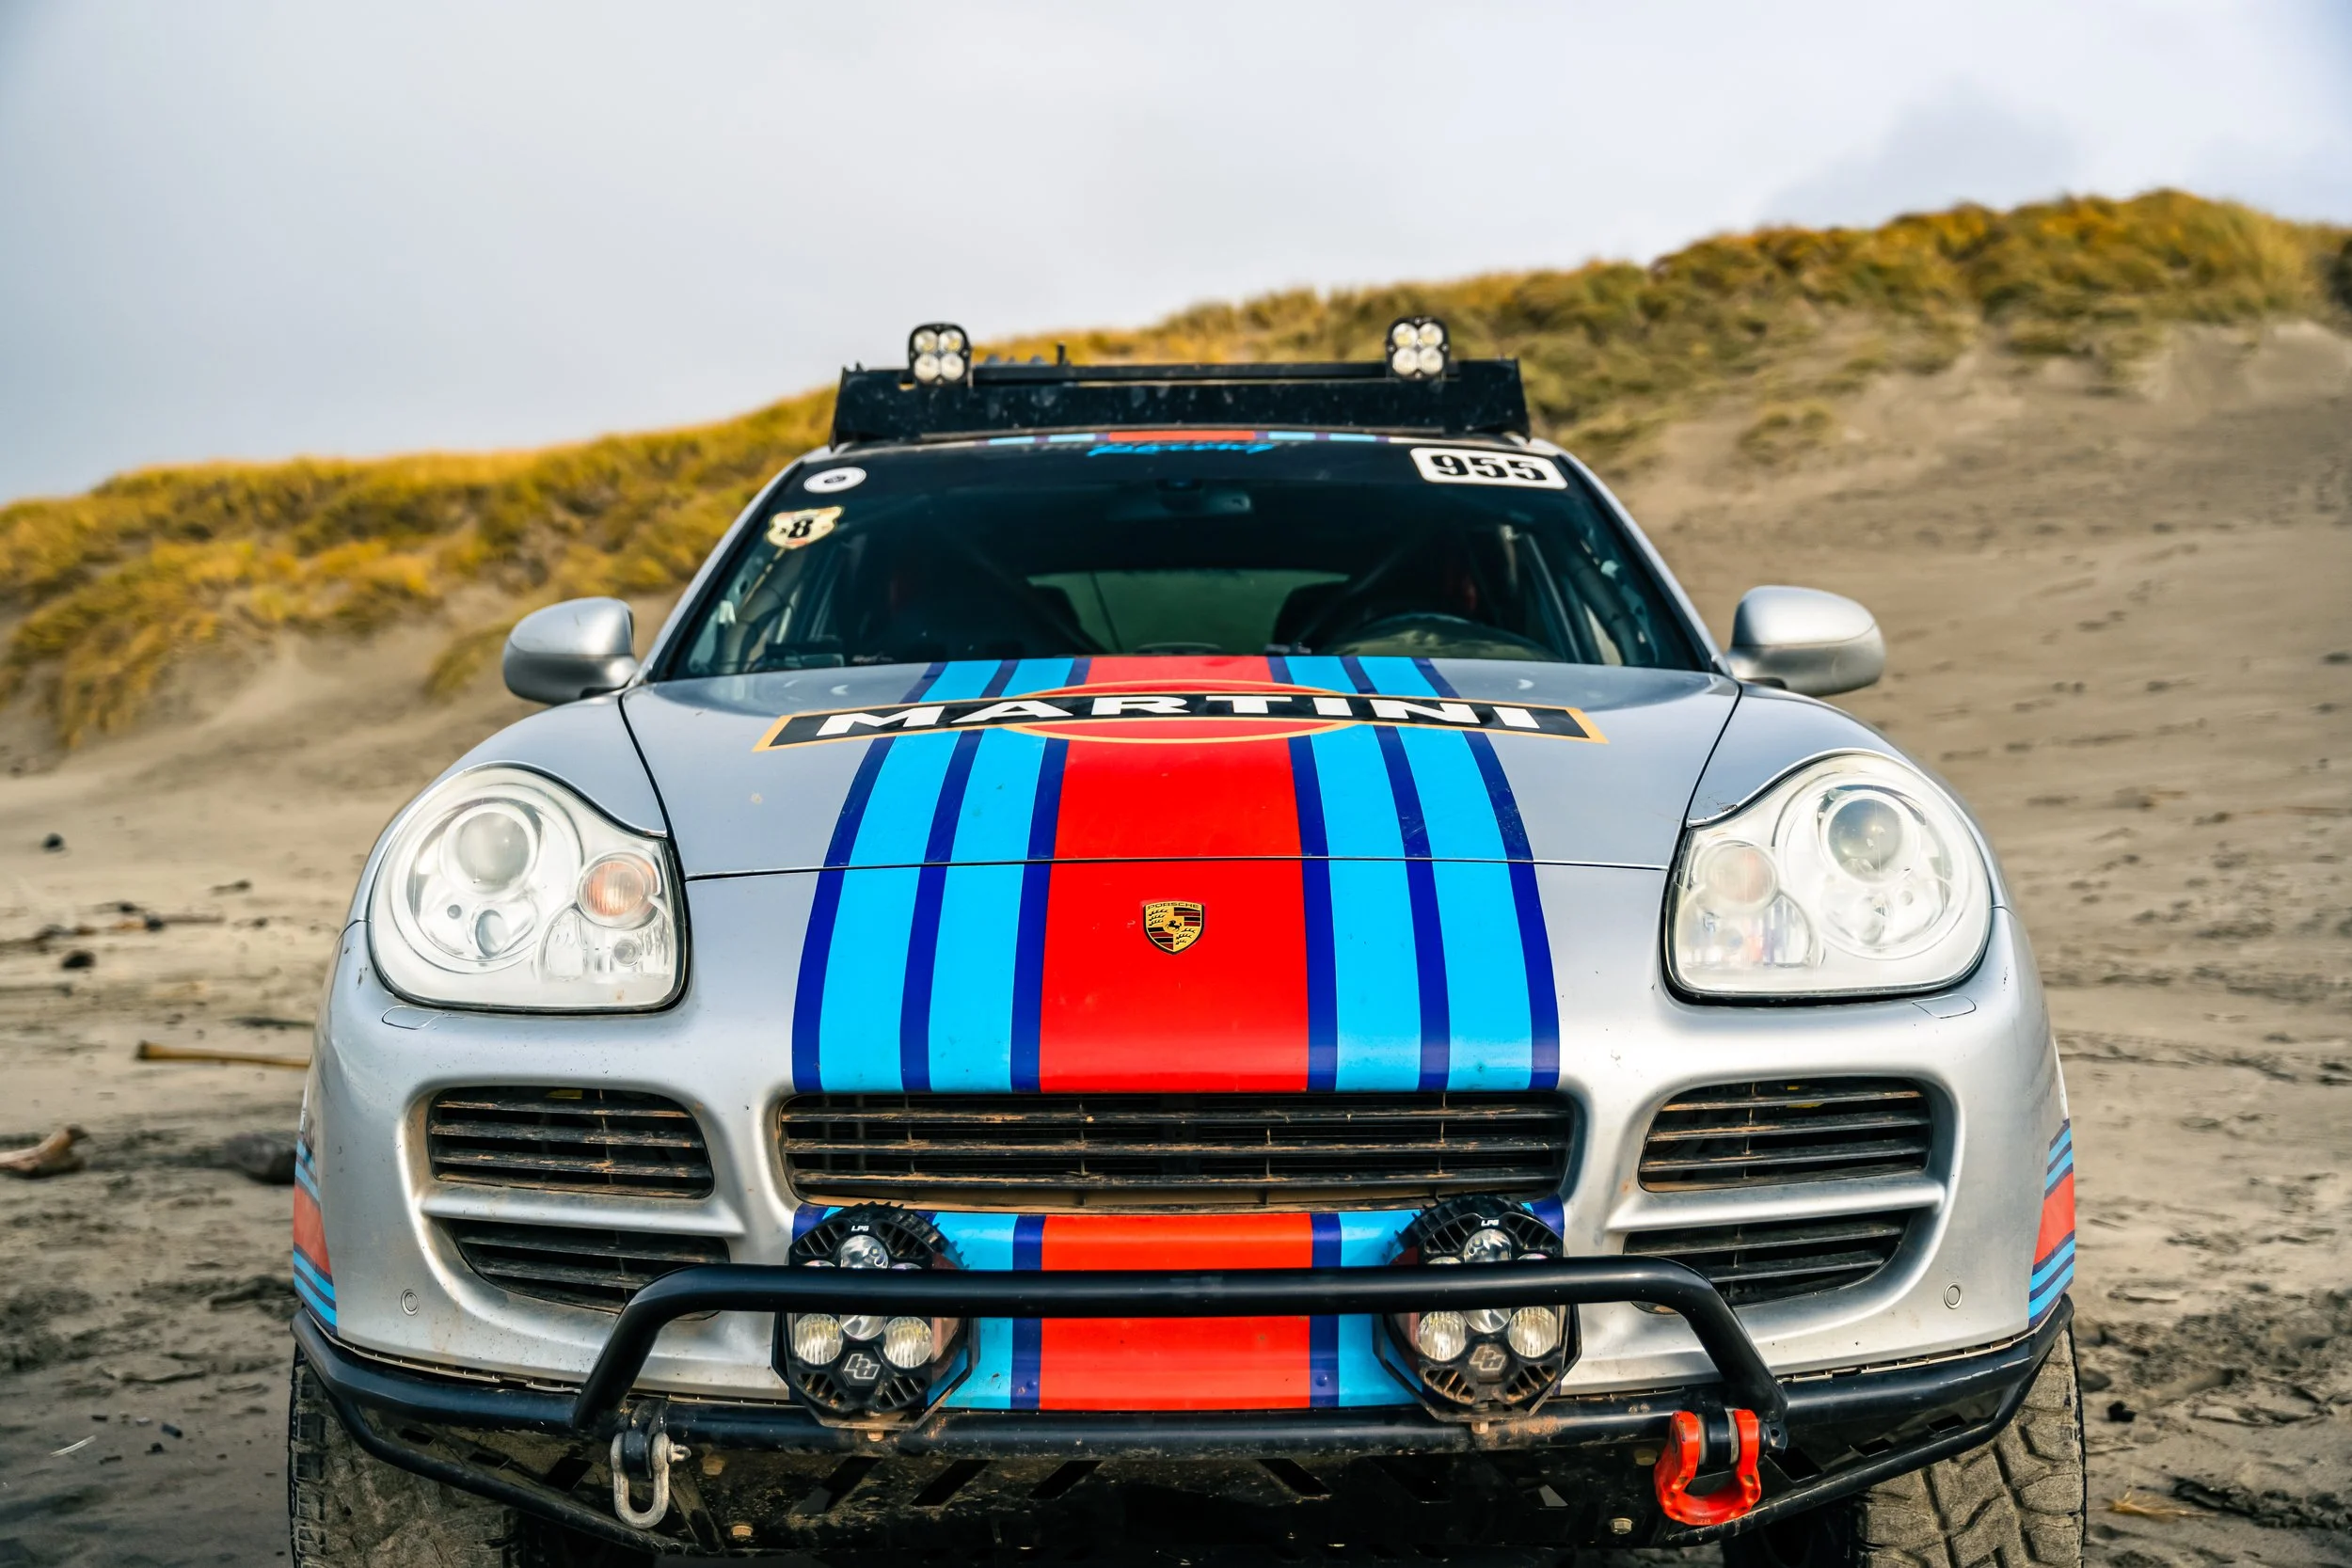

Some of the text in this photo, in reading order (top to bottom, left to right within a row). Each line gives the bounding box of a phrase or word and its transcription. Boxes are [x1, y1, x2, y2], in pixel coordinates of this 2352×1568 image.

[1430, 455, 1547, 481] 955
[788, 517, 814, 538] 8
[816, 695, 1540, 736] MARTINI
